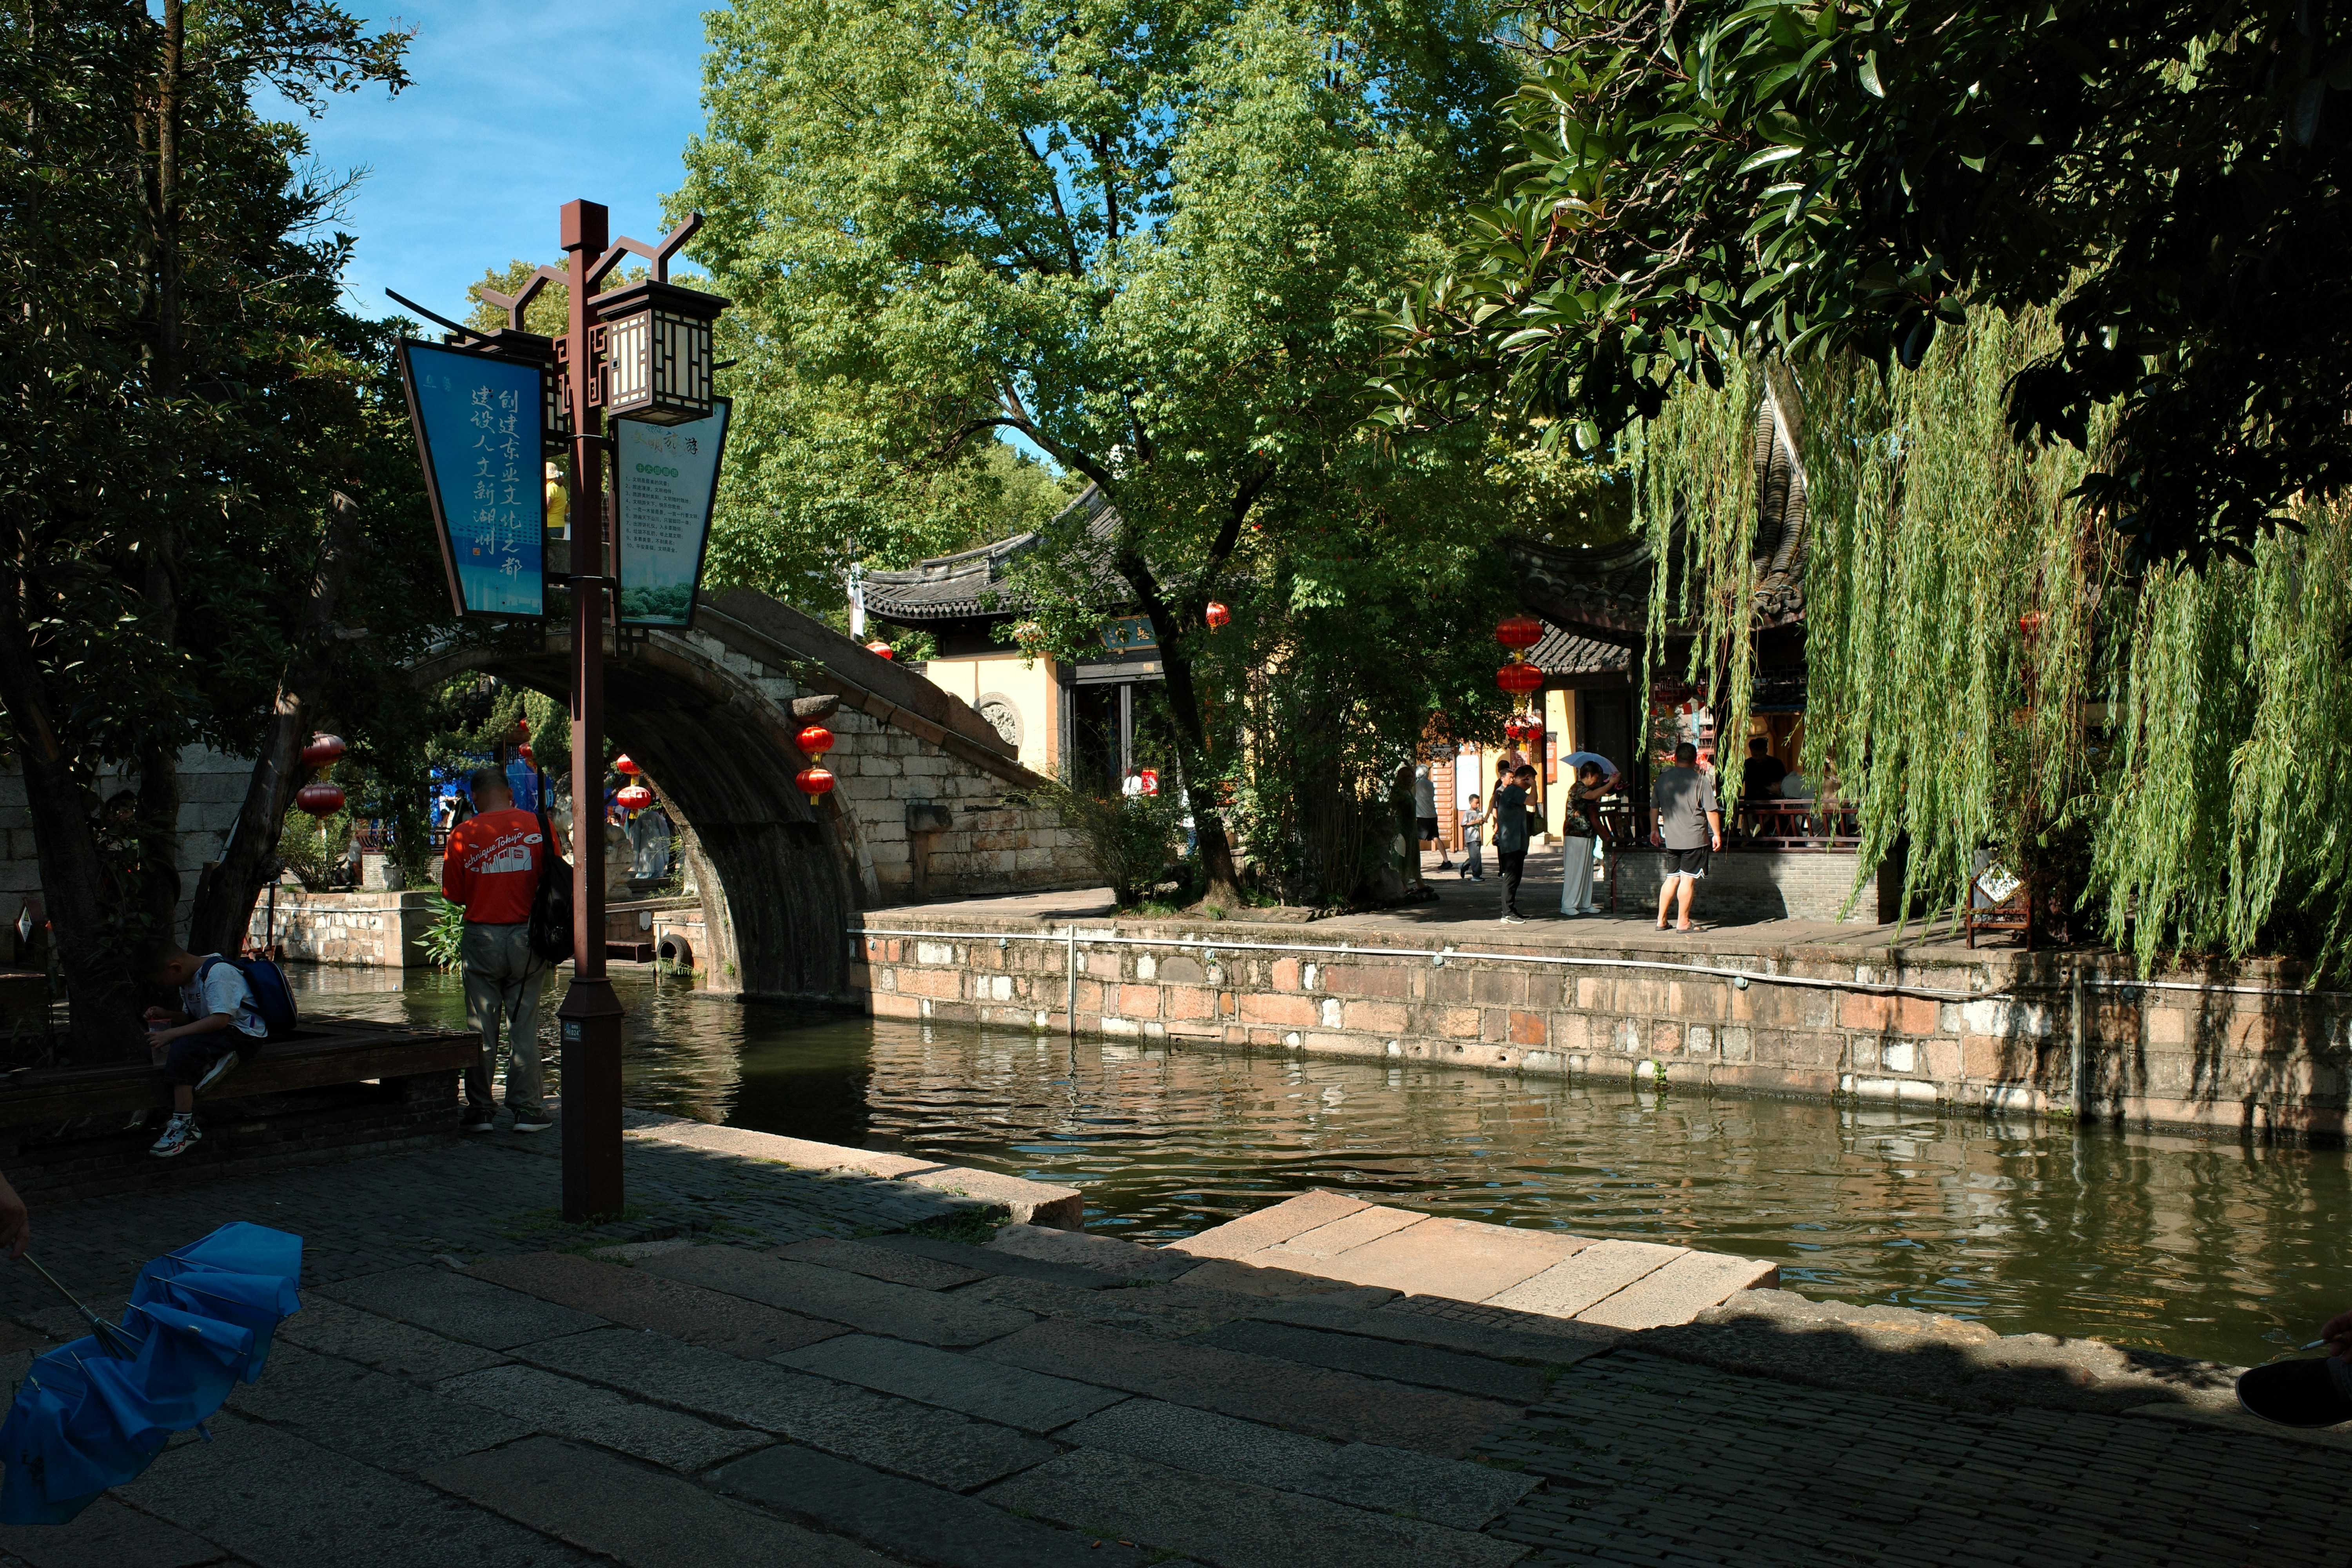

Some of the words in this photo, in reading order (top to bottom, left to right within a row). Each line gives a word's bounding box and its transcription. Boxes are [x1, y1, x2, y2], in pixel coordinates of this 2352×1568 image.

[632, 430, 699, 455] 文明旅游
[470, 385, 496, 555] 建设人文新湖州
[499, 389, 523, 582] 创建东亚文化之都
[636, 464, 679, 477] 十大提醒语
[464, 844, 497, 869] echnique
[495, 831, 524, 848] Tokyo
